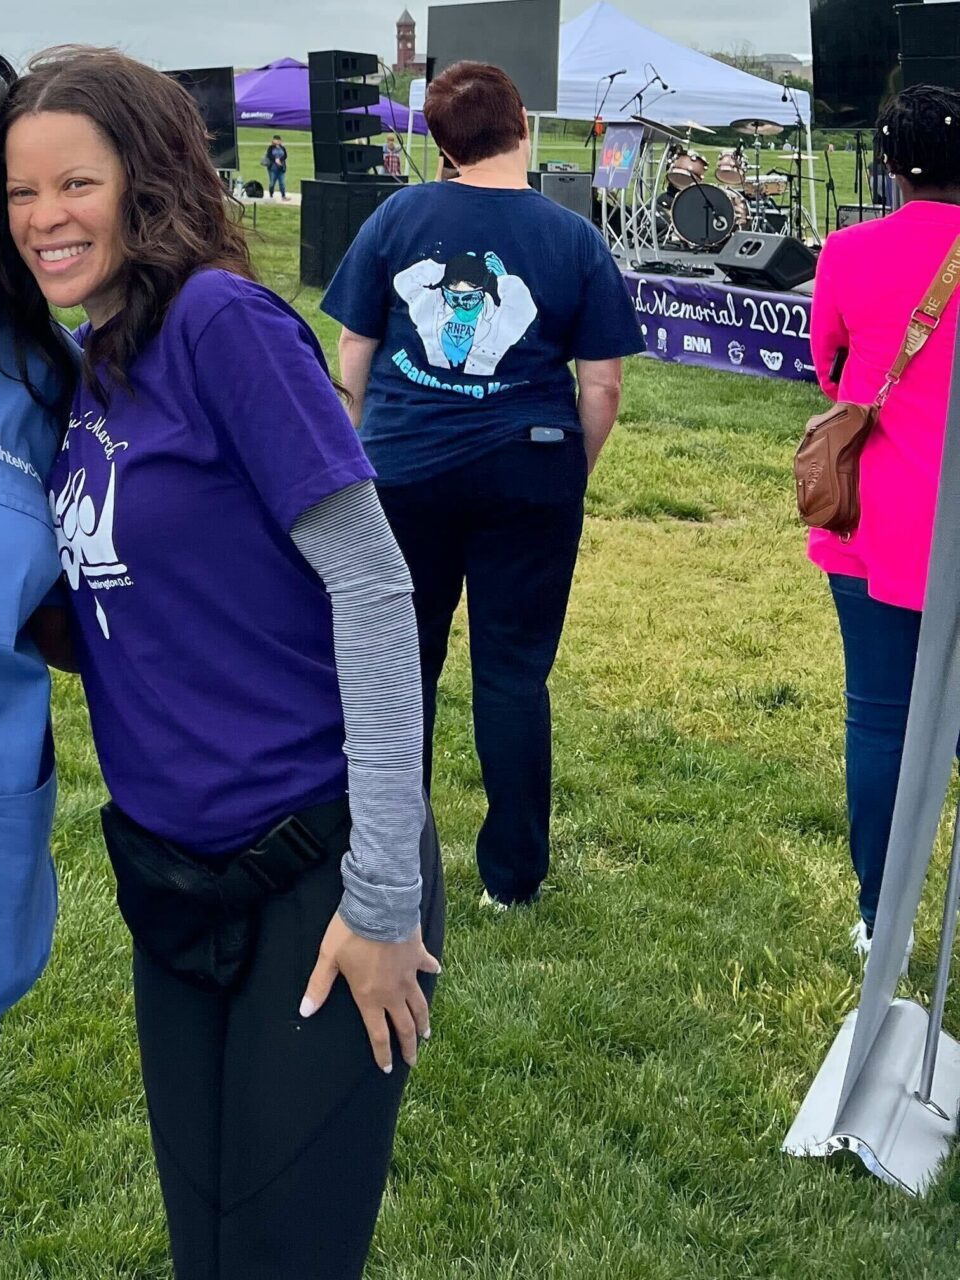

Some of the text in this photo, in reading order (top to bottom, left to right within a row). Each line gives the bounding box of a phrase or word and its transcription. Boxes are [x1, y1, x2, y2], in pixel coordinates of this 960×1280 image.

[646, 290, 743, 328] Memorial
[743, 297, 810, 339] 2022
[683, 335, 712, 354] BNM
[85, 416, 129, 461] March
